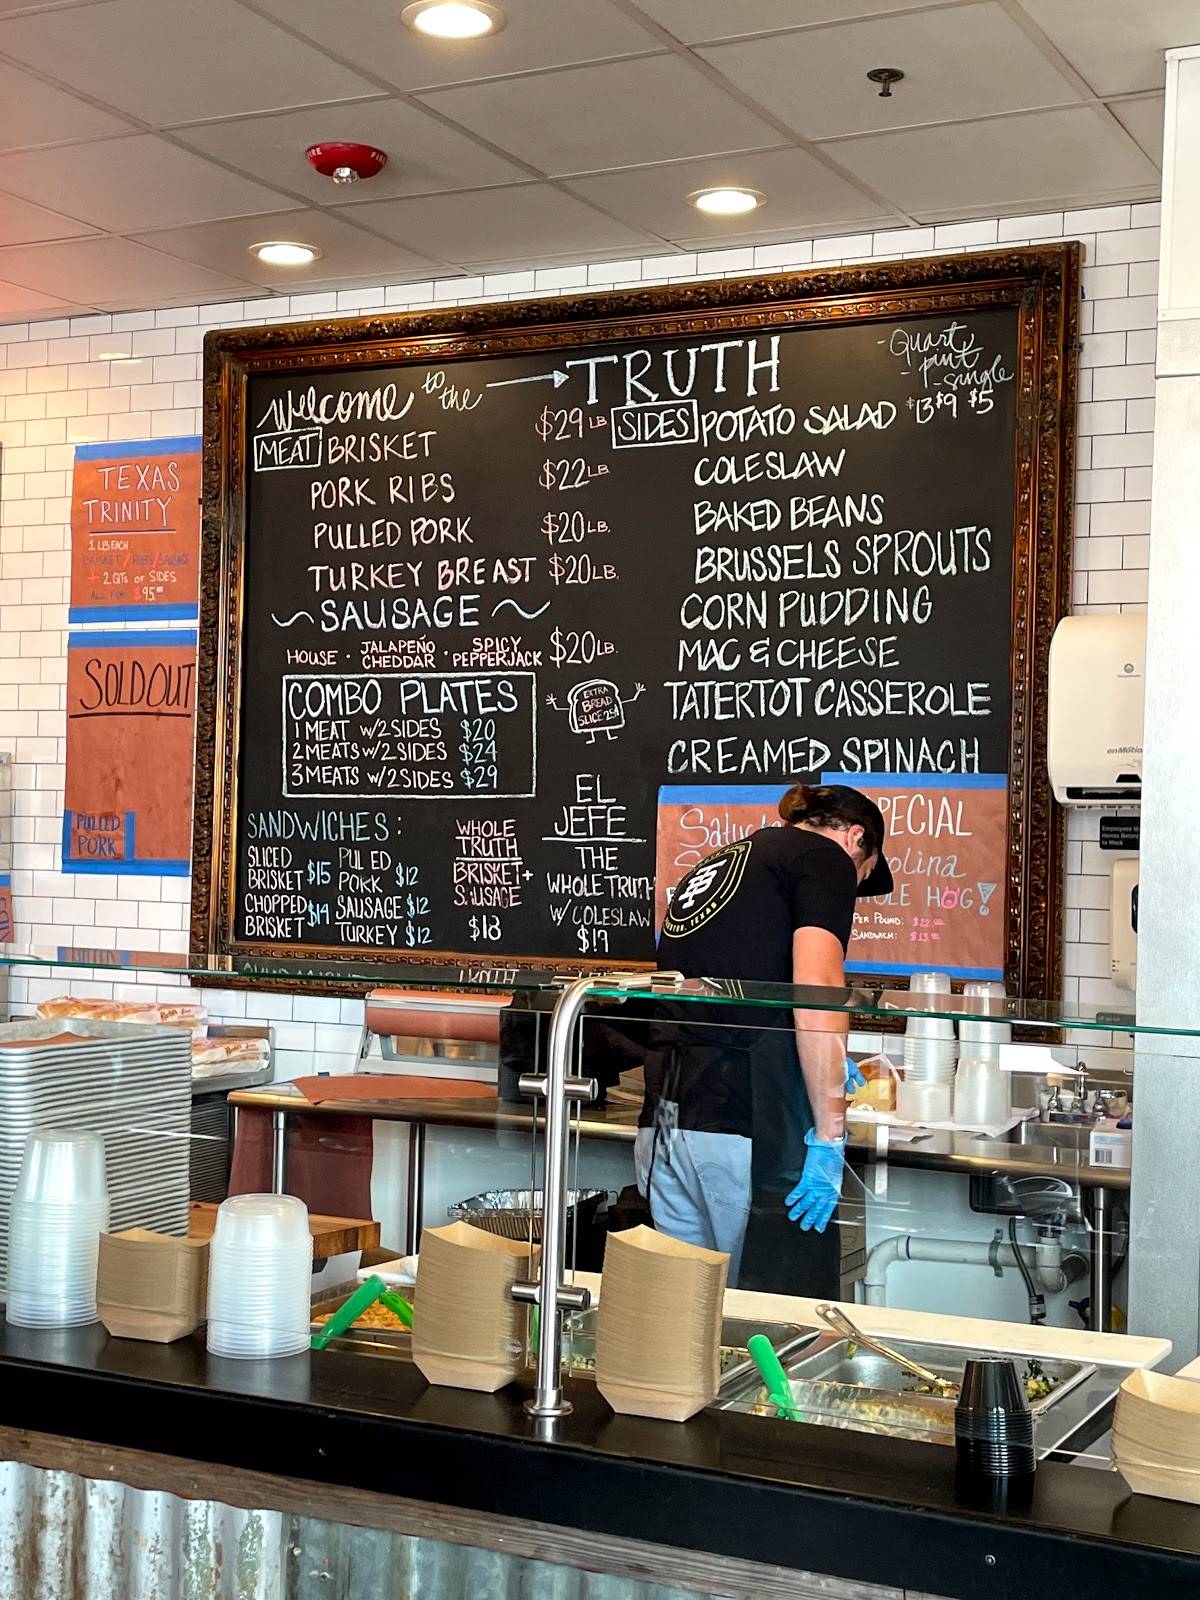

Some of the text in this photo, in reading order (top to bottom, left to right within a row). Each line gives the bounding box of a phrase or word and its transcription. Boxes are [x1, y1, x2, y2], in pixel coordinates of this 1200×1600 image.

[566, 336, 780, 405] TRUTH
[421, 370, 483, 411] to the
[256, 383, 415, 431] Welcome
[259, 432, 319, 465] MEAT
[328, 431, 437, 465] BRISKET
[535, 405, 583, 442] $29
[618, 407, 691, 441] SIDES
[701, 404, 796, 447] POTATO
[804, 401, 896, 431] SALAD
[98, 461, 180, 492] TEXAS
[694, 448, 846, 486] COLESLAW
[311, 477, 376, 510] PORK
[389, 473, 455, 504] RIBS
[83, 497, 172, 526] TRINITY
[694, 494, 884, 535] BAKED BEANS
[314, 519, 400, 549] PULLED
[411, 516, 473, 547] PORK
[694, 526, 992, 584] BRUSSELS SPROUTS
[149, 569, 177, 582] SIDES
[308, 562, 423, 592] TURKEY
[437, 557, 536, 591] BREAST
[320, 594, 481, 633] SAUSAGE
[680, 587, 934, 631] CORN PUDDING
[286, 649, 339, 667] HOUSE
[472, 636, 522, 653] SPICY
[678, 635, 900, 672] MAC & CHEESE
[361, 653, 437, 670] CHEDDAR
[288, 678, 519, 721] COMBO PLATES
[581, 696, 613, 713] BREAD
[582, 686, 609, 699] EXTRA
[814, 683, 993, 718] CASSEROLE
[305, 719, 351, 741] MEAT
[460, 718, 496, 742] $20
[577, 709, 602, 727] SLICE
[305, 741, 360, 761] MEATS
[458, 740, 499, 765] $24
[667, 736, 981, 775] CREAMED SPINACH
[305, 765, 360, 786] MEATS
[459, 765, 498, 789] $29
[576, 774, 616, 803] EL
[76, 813, 120, 832] PULLED
[455, 819, 517, 838] WHOLE
[554, 805, 627, 837] JEFE
[868, 793, 973, 839] PECIAL
[78, 834, 117, 856] PORK
[247, 845, 293, 868] SLICED
[455, 836, 518, 857] TRUTH
[574, 846, 619, 871] THE
[338, 847, 392, 871] PULED
[248, 860, 332, 891] BRISKET $15
[395, 862, 419, 887] $12
[546, 871, 604, 897] WHOLE
[245, 893, 307, 914] CHOPPED
[335, 893, 432, 920] SAUSAGE $12
[572, 904, 651, 926] COLESLAW
[245, 915, 306, 938] BRISKET
[335, 920, 433, 947] TURKEY $12
